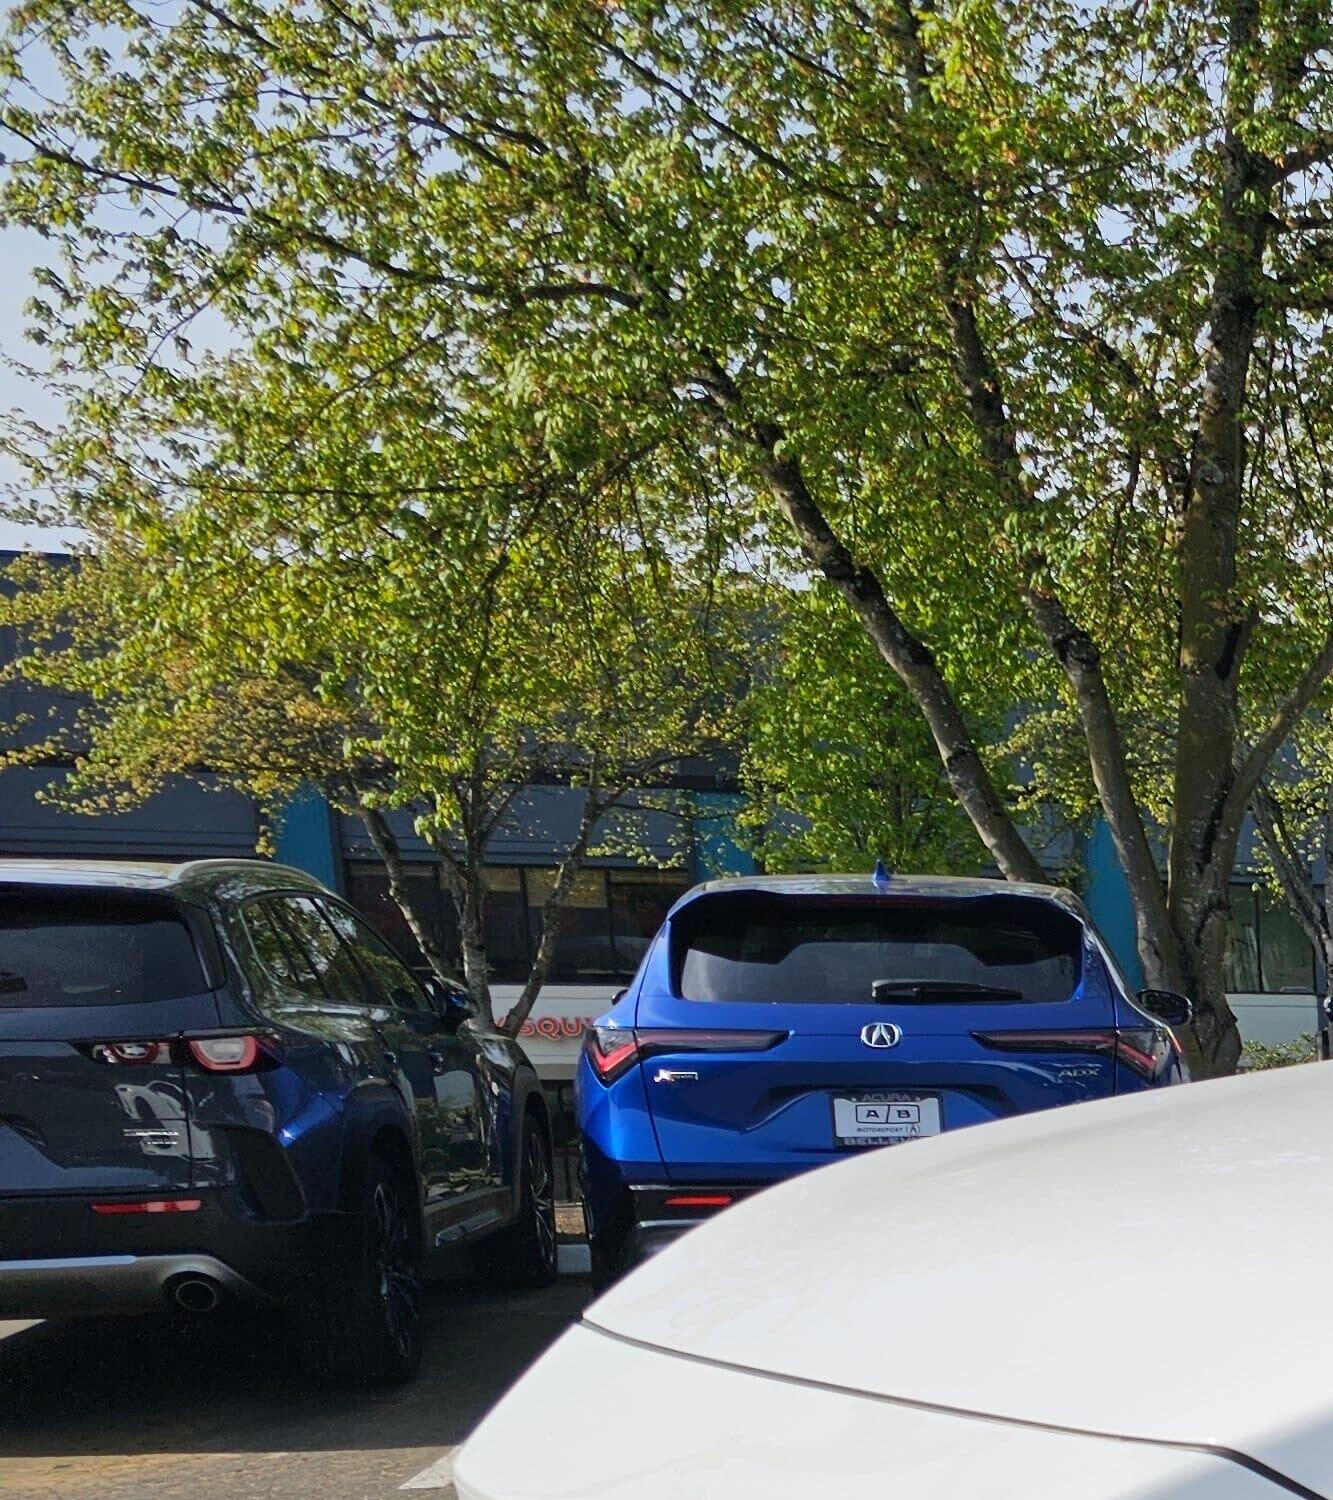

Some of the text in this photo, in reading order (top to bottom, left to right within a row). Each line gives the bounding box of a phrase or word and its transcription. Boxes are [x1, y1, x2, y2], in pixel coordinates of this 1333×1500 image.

[863, 1093, 911, 1102] ACURA
[866, 1109, 911, 1119] A B
